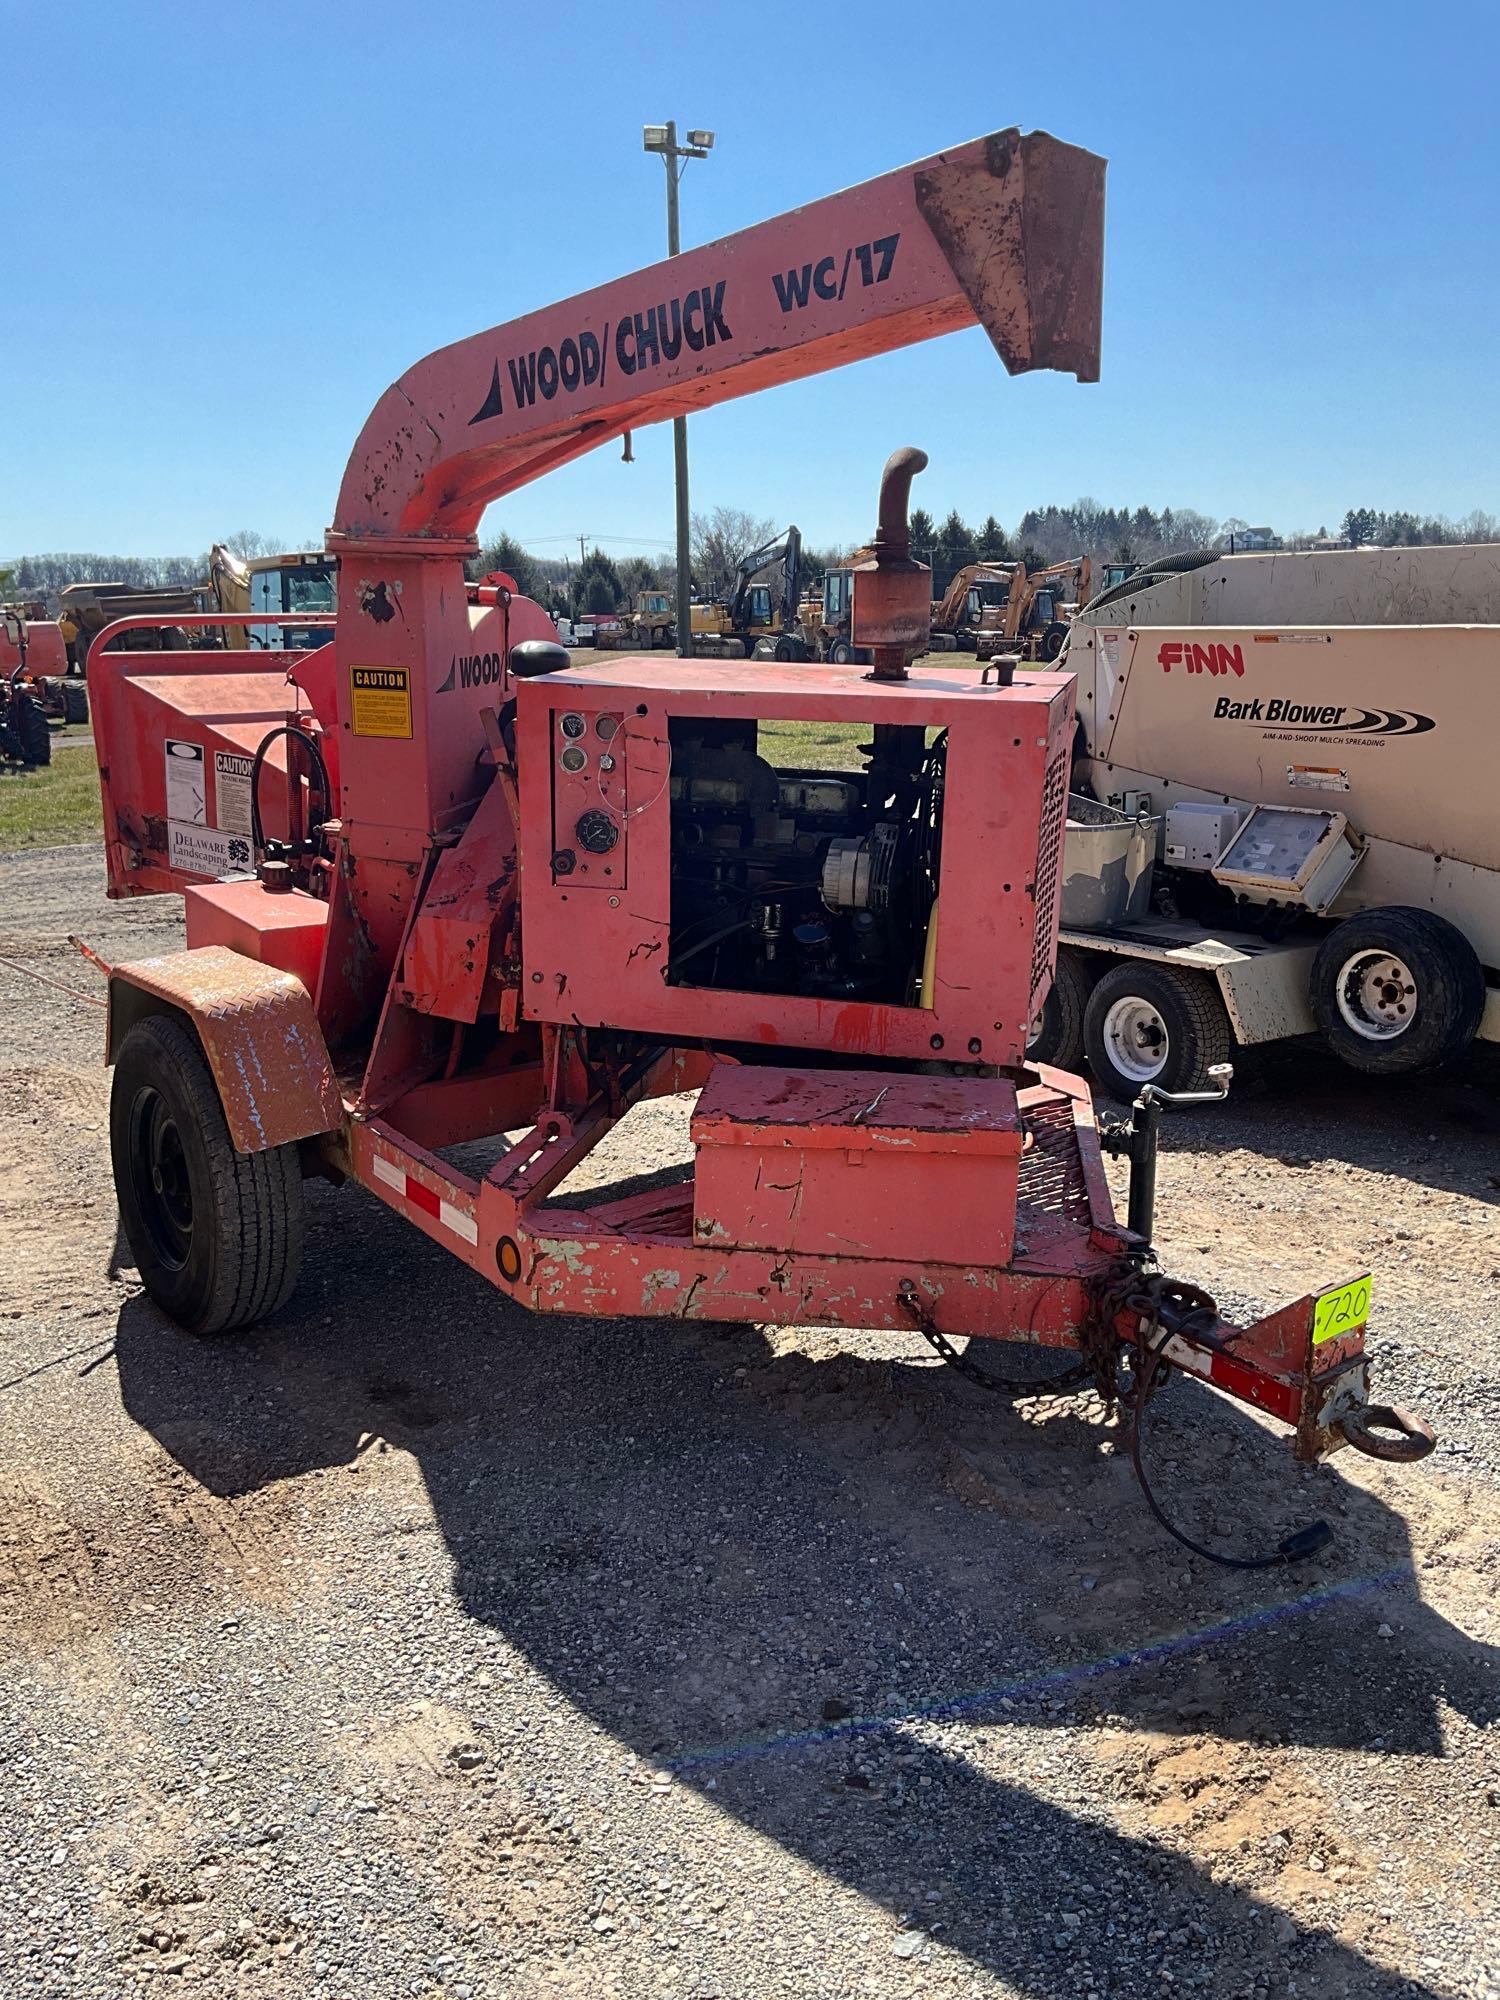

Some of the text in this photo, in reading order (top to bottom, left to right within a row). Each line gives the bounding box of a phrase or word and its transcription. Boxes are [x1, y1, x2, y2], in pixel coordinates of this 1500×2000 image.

[772, 233, 900, 312] WC/17
[356, 672, 403, 687] CAUTION
[1214, 697, 1346, 724] Bark Blower
[1262, 732, 1386, 747] AIM-AND-SHOOT MULCH SPREADING
[216, 755, 255, 777] CAUTION
[175, 831, 227, 855] DELAWARE
[173, 844, 229, 868] Landscaping
[1323, 1287, 1367, 1332] 720
